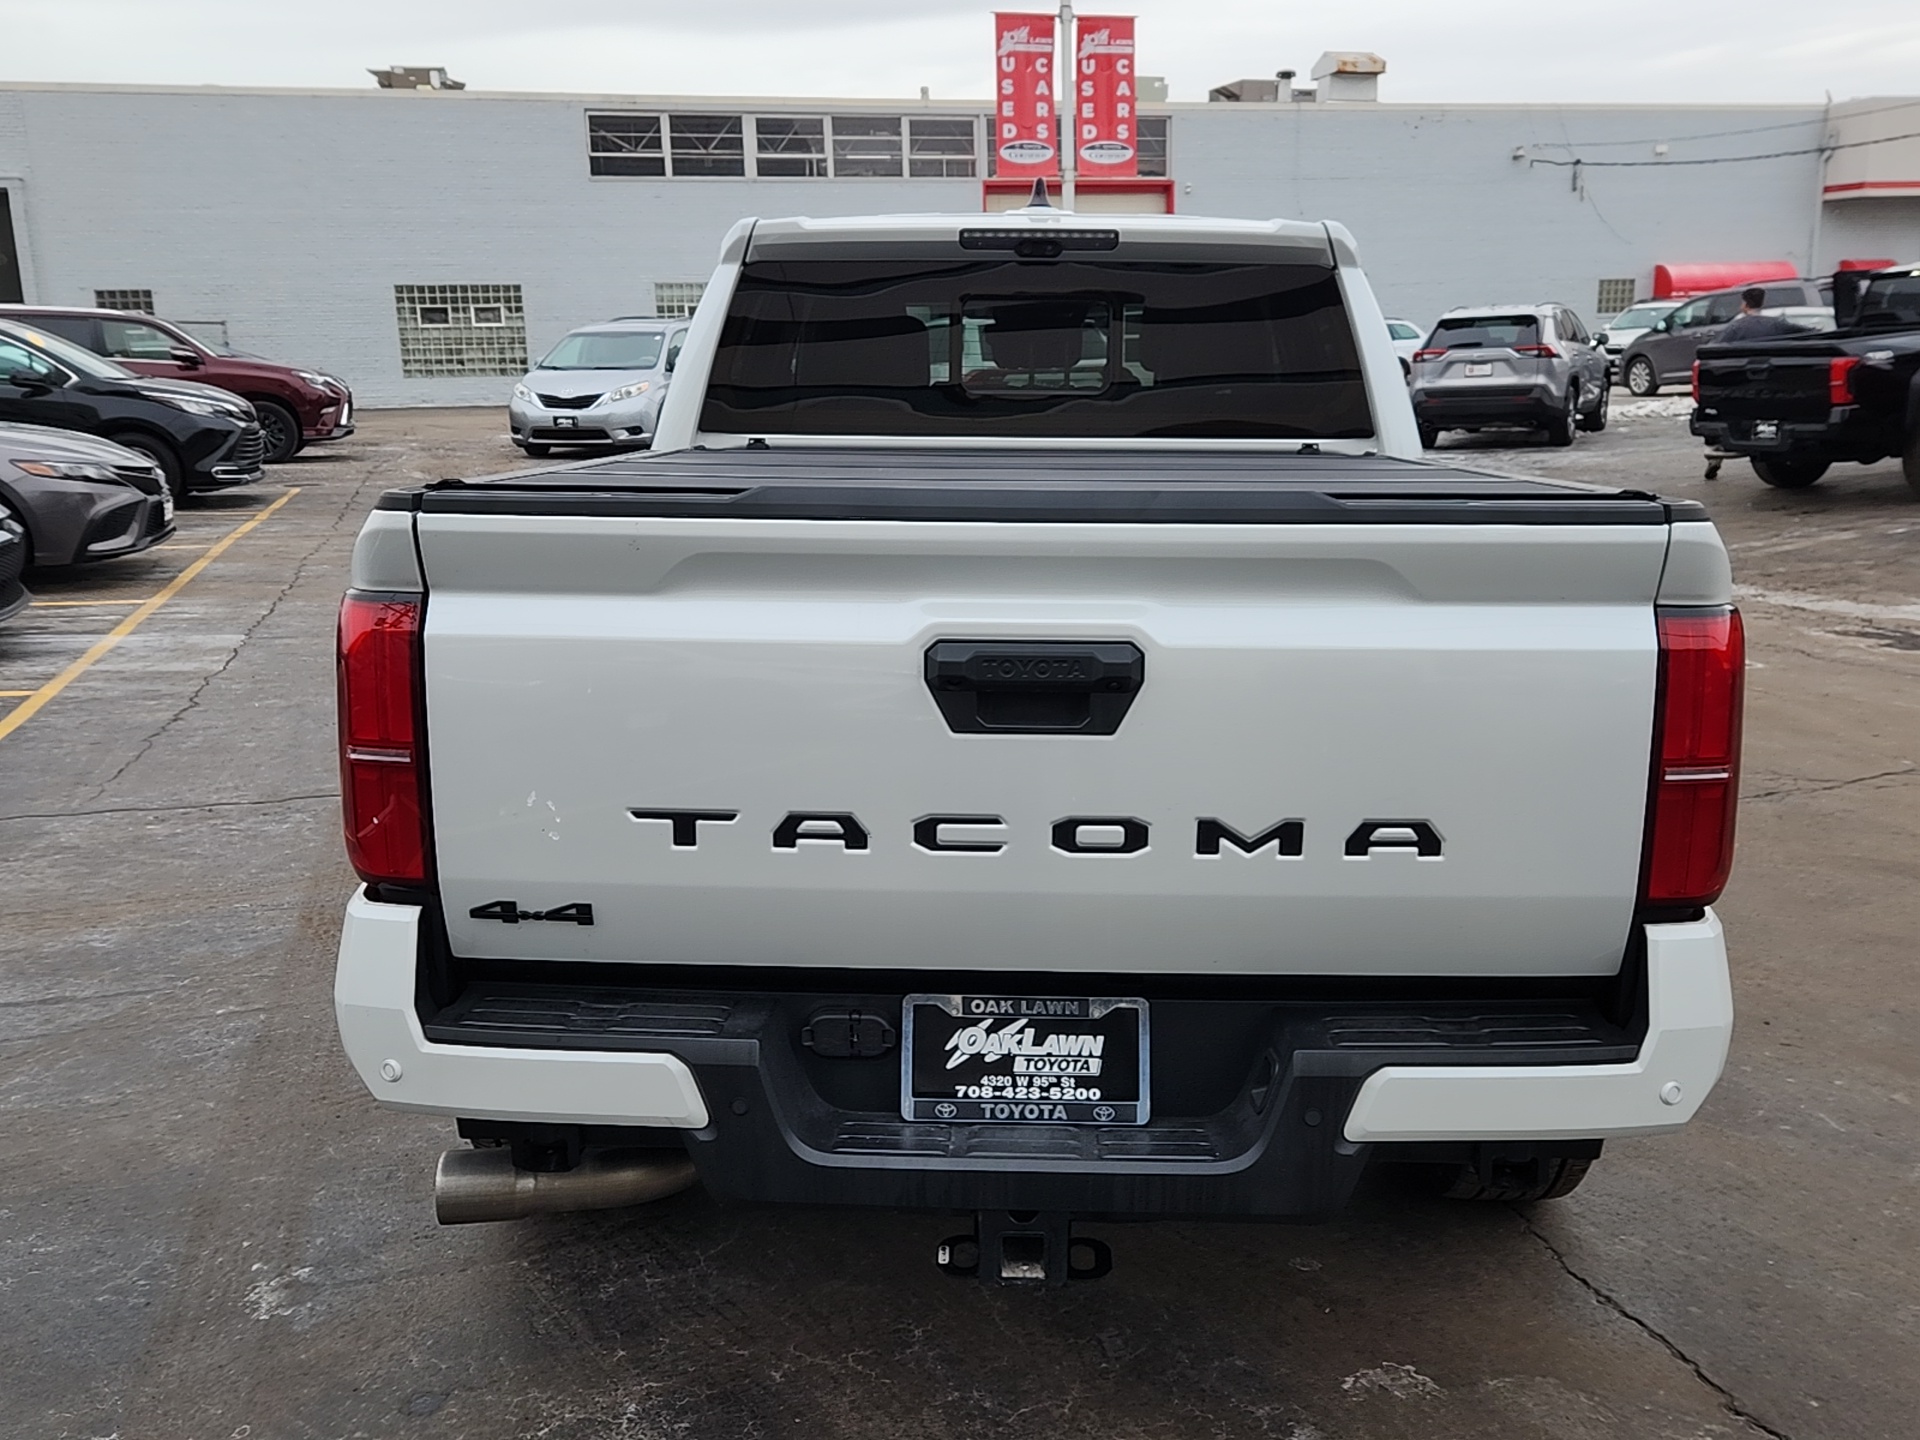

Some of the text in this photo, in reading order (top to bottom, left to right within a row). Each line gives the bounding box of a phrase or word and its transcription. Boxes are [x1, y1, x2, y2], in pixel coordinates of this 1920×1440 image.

[1001, 56, 1018, 139] USED
[1035, 57, 1049, 139] CARS
[1081, 59, 1098, 140] USED
[1116, 59, 1131, 140] CARS
[982, 659, 1086, 678] TOYOTA
[626, 807, 1446, 860] TACOMA
[970, 999, 1079, 1015] OAK LAWN
[1023, 1057, 1091, 1072] TOYOTA
[980, 1075, 1012, 1087] 4320
[1015, 1076, 1029, 1087] W
[1060, 1076, 1075, 1088] St
[954, 1085, 1101, 1101] 708-423-5200
[980, 1103, 1068, 1120] TOYOTA
